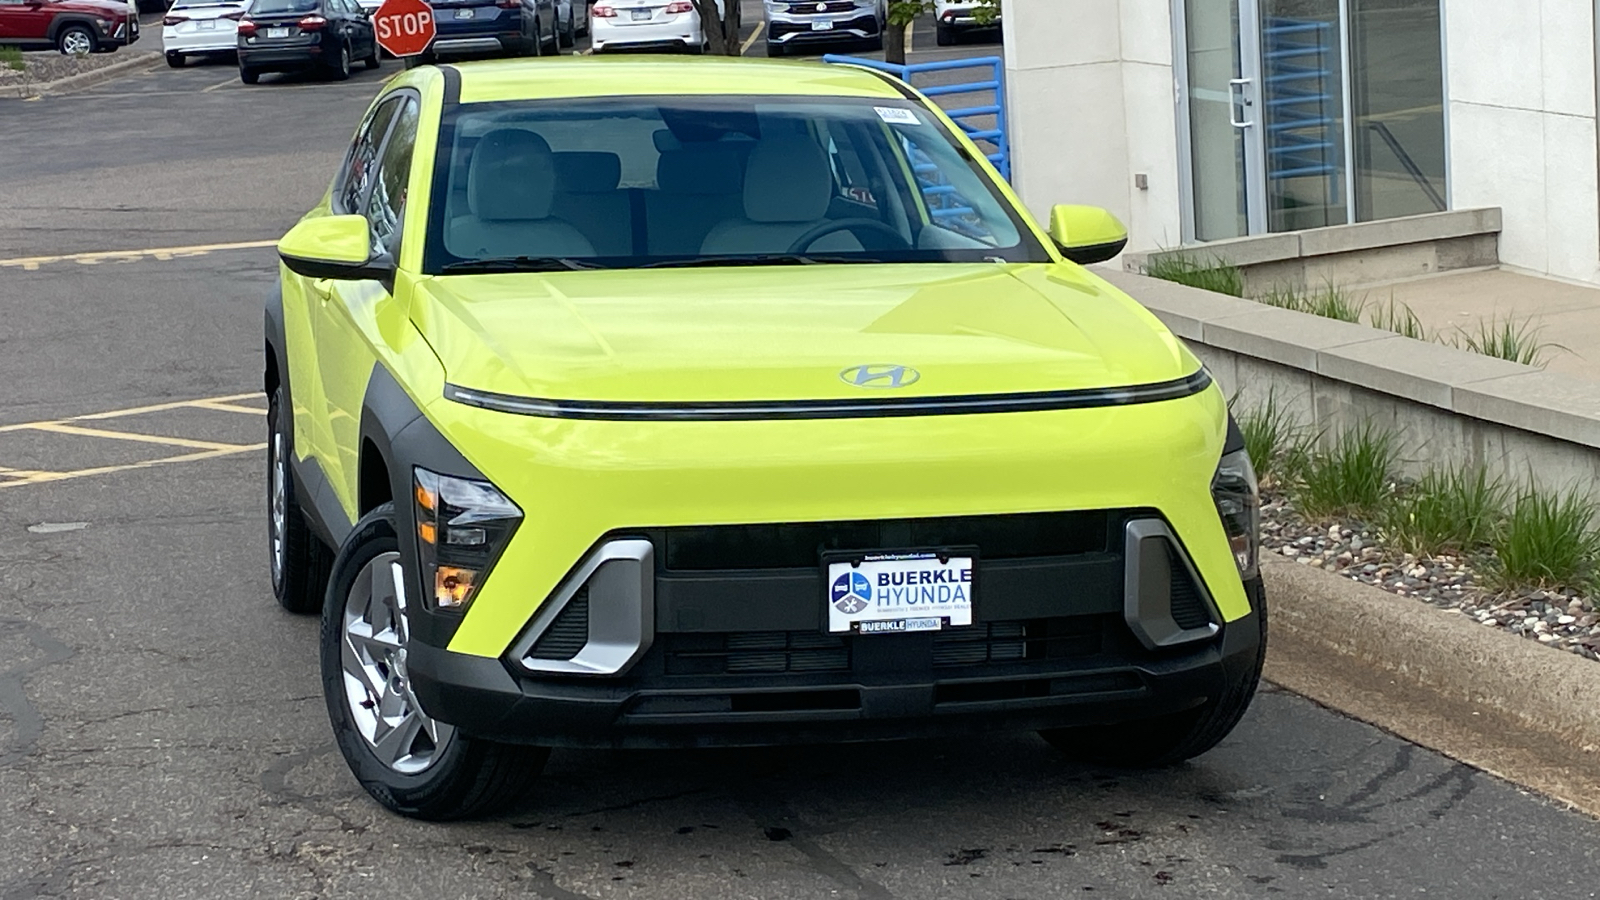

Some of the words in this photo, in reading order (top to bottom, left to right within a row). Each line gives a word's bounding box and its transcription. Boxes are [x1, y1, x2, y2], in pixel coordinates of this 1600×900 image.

[378, 11, 431, 39] STOP
[877, 569, 972, 586] BUERKLE
[861, 620, 905, 631] BUERKLE
[907, 618, 939, 629] HYUNDAI
